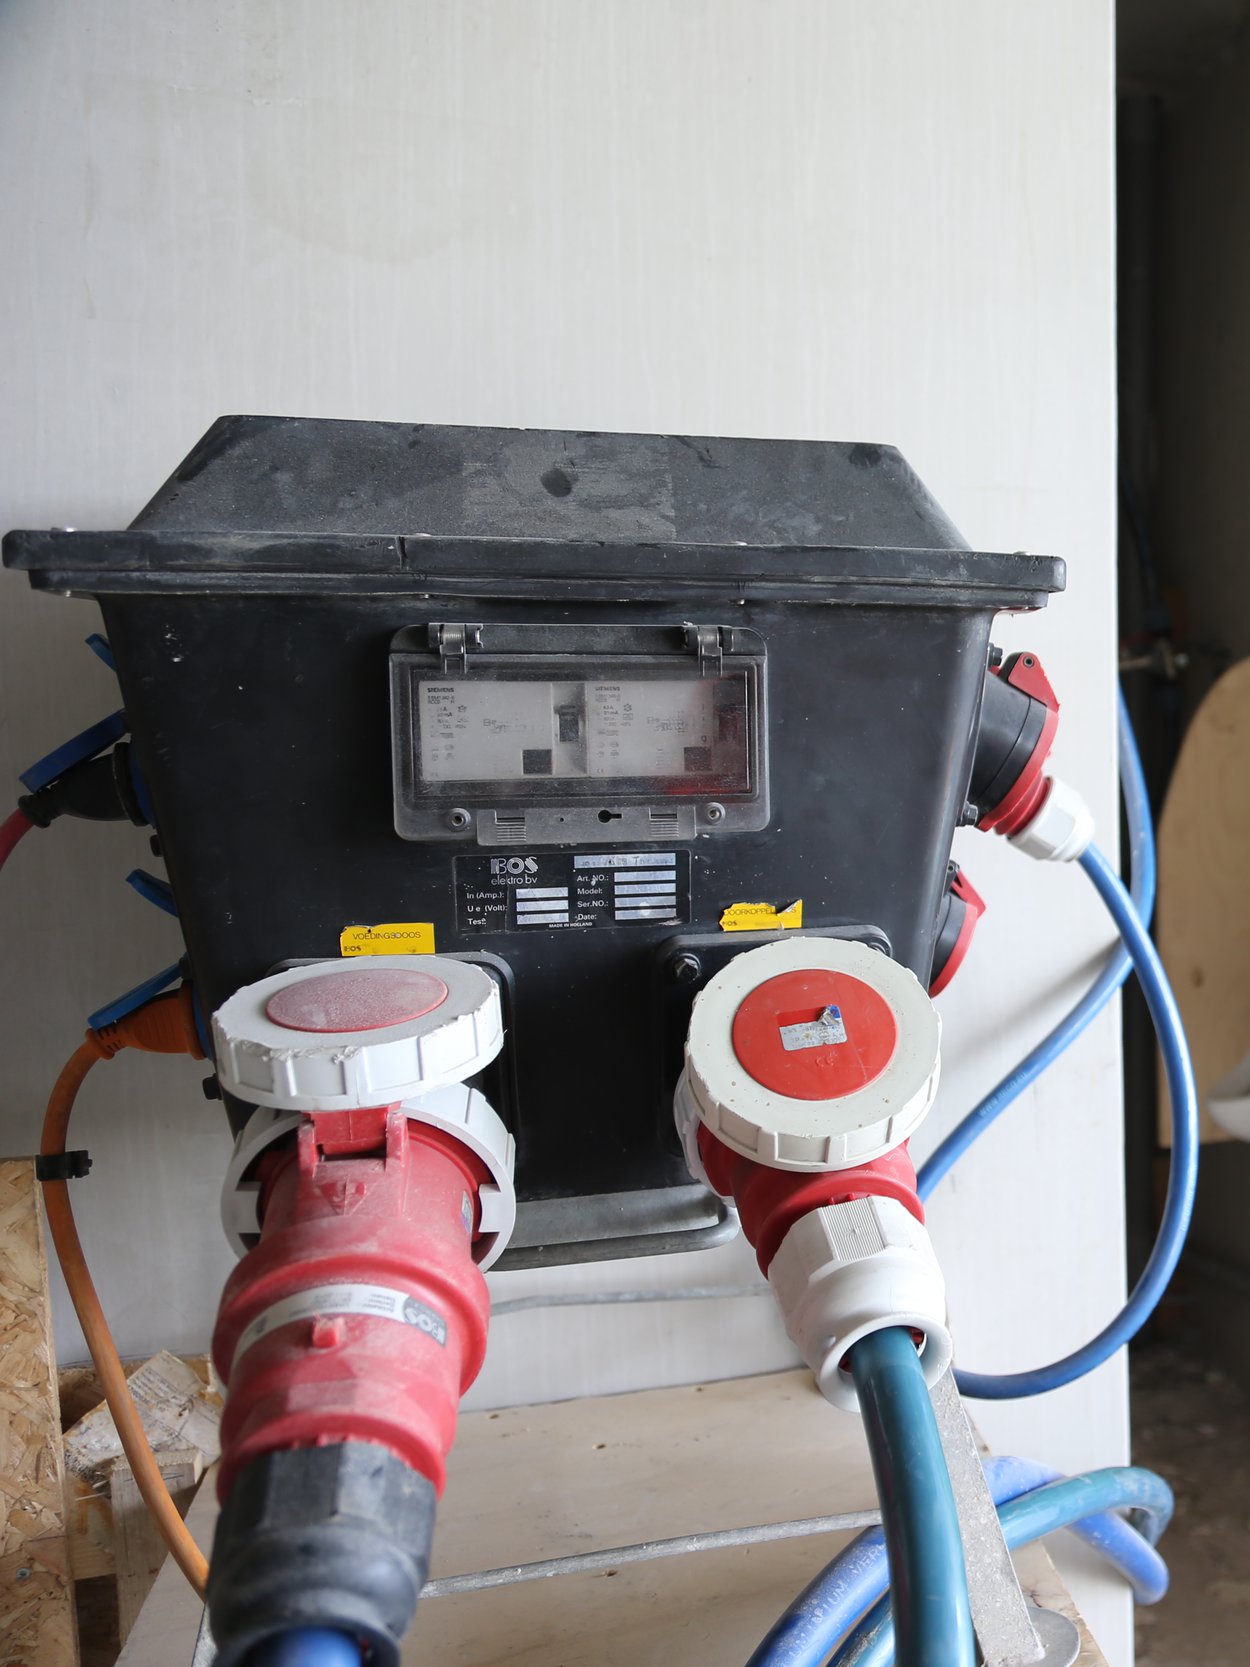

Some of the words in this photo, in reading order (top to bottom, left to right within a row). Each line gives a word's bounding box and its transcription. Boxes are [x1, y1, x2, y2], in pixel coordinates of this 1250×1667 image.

[490, 856, 538, 874] BOS
[491, 874, 523, 885] elektro
[525, 873, 537, 884] bv
[476, 891, 504, 900] (Amp.):
[484, 904, 507, 912] (Volt):
